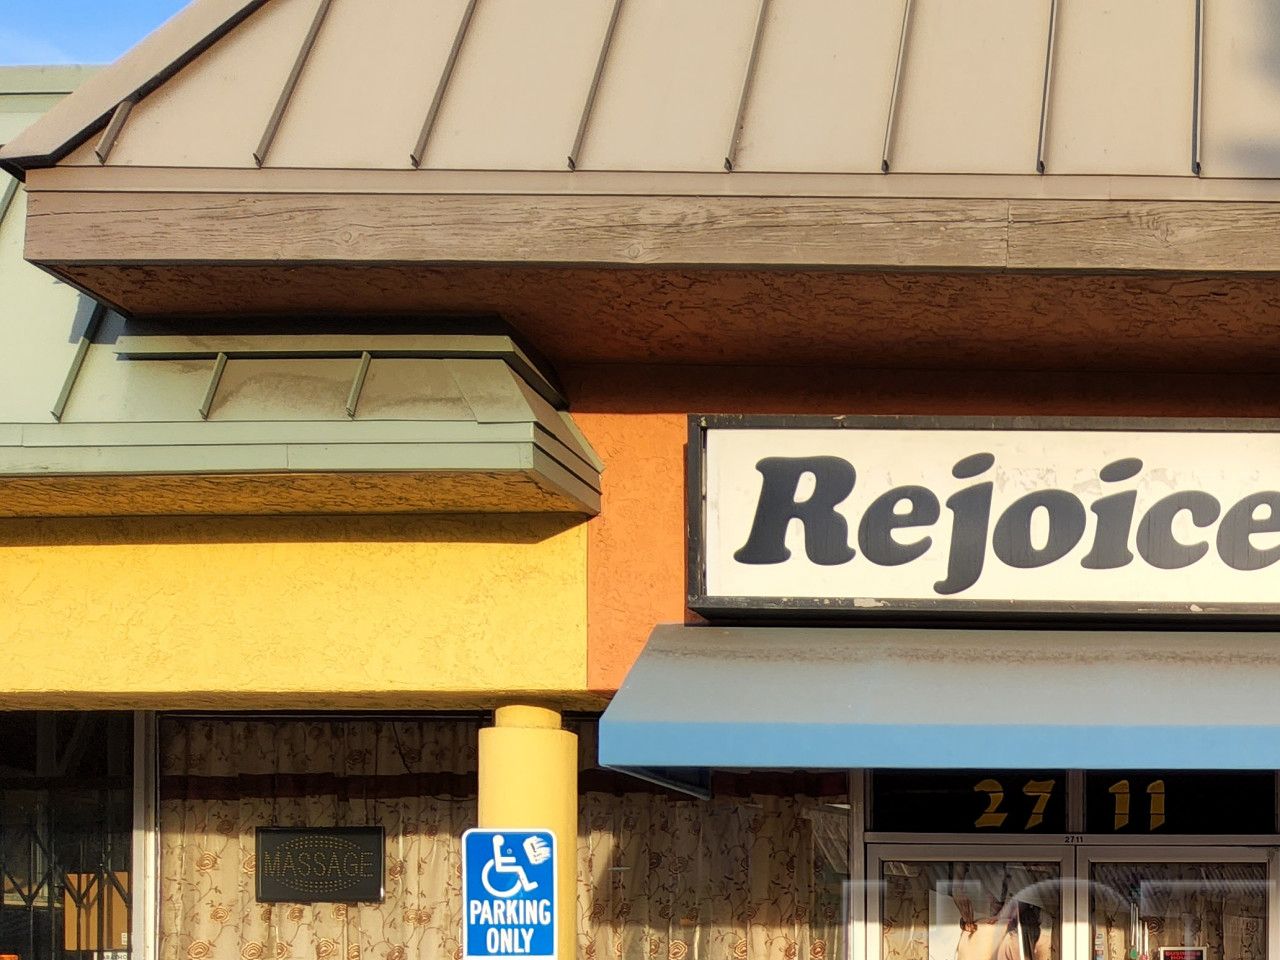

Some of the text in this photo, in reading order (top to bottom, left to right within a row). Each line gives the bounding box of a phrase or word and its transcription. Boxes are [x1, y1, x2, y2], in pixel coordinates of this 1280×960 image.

[1064, 835, 1084, 843] 2711
[264, 850, 374, 877] MASSAGE
[469, 899, 552, 926] PARKING
[486, 927, 535, 955] ONLY
